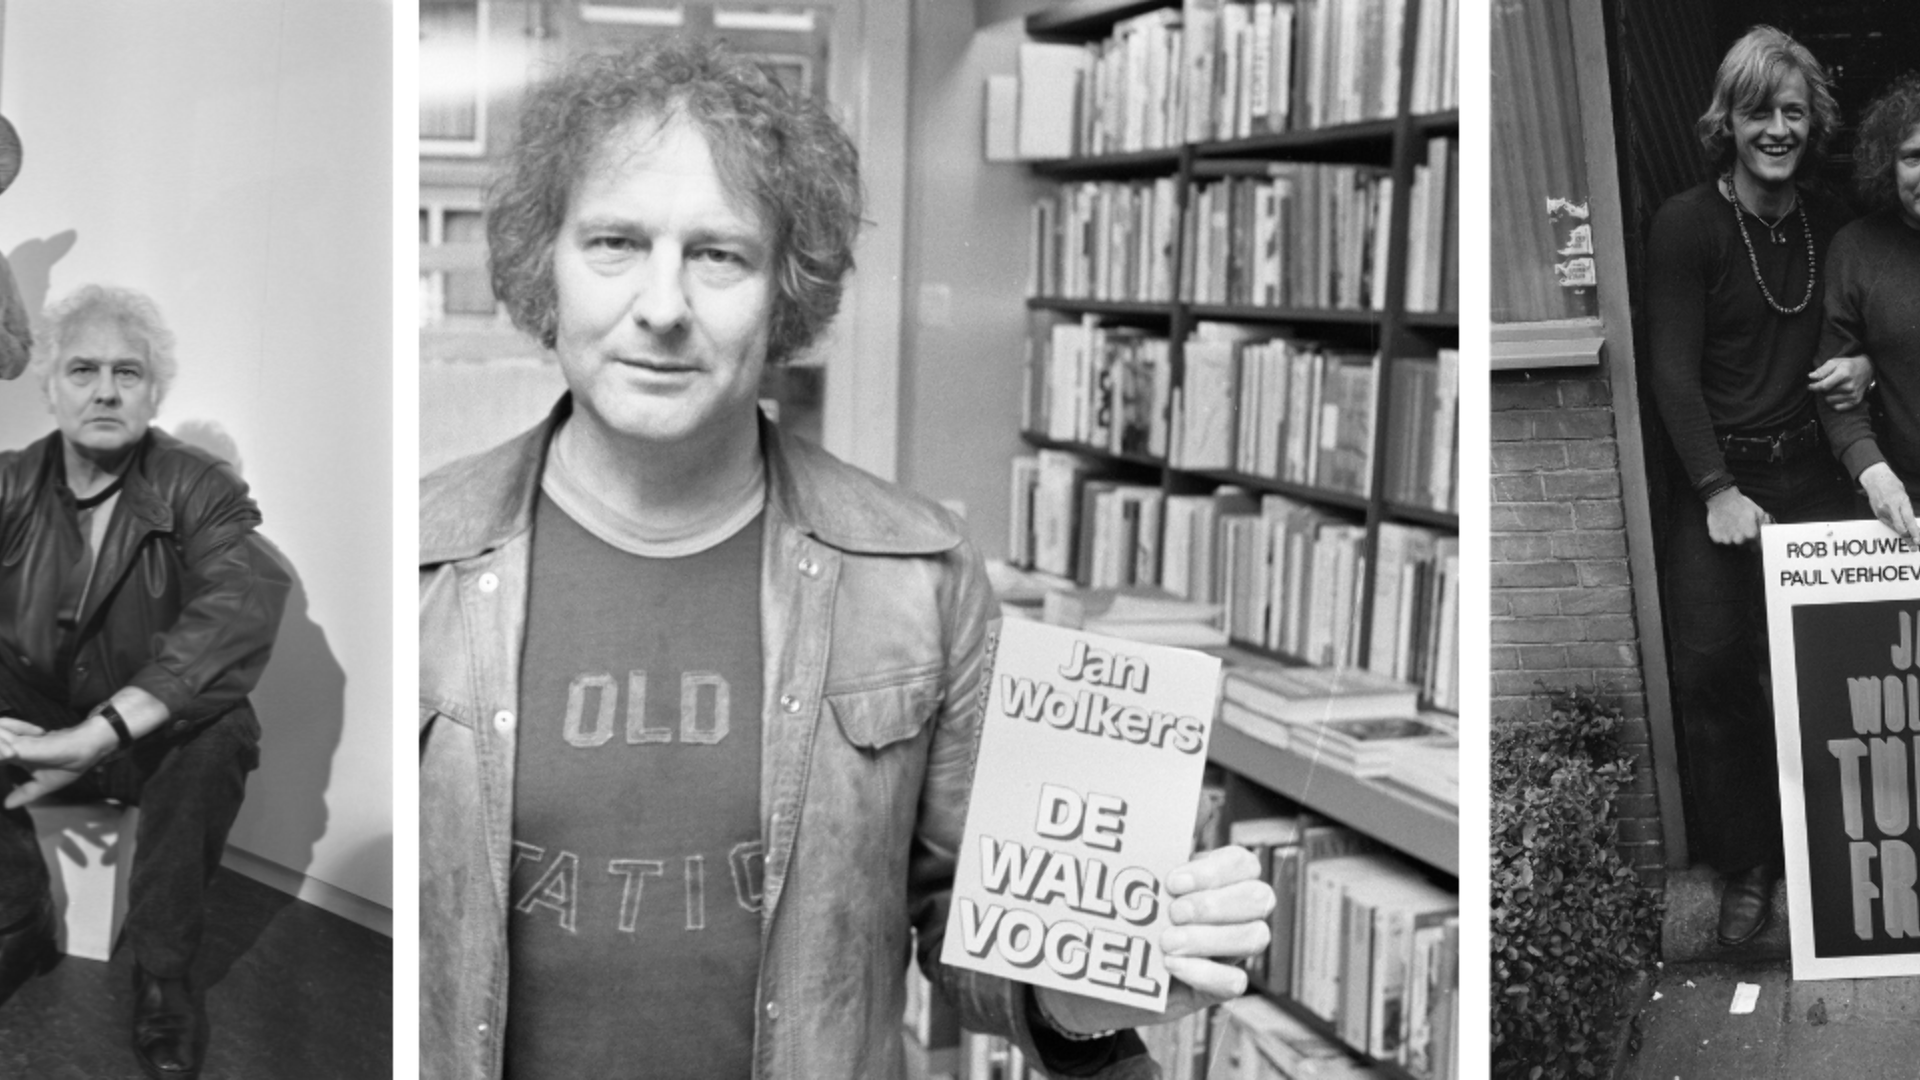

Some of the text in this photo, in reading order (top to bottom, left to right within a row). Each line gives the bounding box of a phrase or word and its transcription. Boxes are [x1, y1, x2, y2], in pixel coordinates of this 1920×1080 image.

[1780, 569, 1828, 586] PAUL
[1787, 537, 1920, 558] ROB HOUWE
[1059, 639, 1149, 692] Jan
[1891, 610, 1920, 670] J
[562, 669, 730, 747] OLD
[1001, 674, 1205, 754] Wolkers
[1036, 782, 1127, 852] DE
[1827, 736, 1920, 840] TU
[979, 834, 1161, 926] WALG
[1849, 840, 1920, 940] FR
[959, 897, 1161, 999] VOGEL
